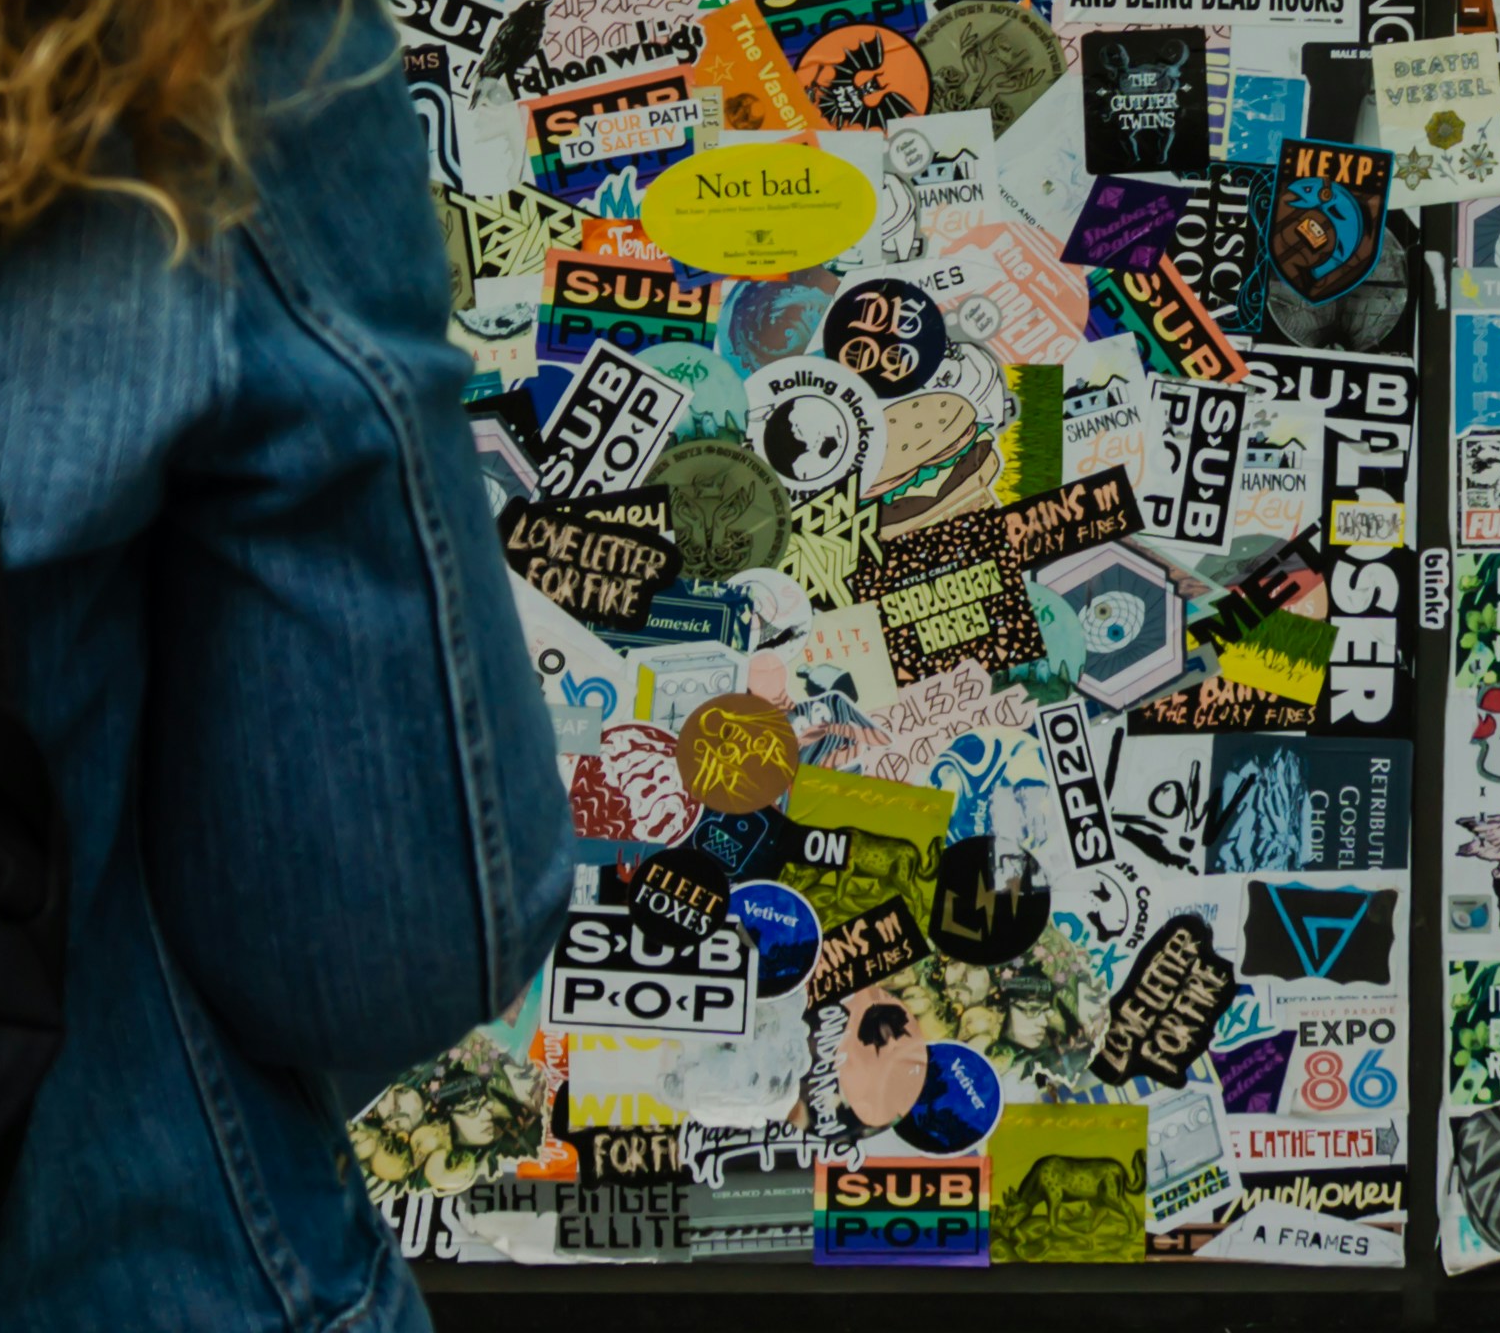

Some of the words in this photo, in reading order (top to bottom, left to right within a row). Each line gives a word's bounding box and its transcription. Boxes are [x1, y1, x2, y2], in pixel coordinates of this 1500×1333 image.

[1128, 73, 1157, 87] THE
[1110, 93, 1179, 112] GUTTER
[586, 117, 639, 135] YOUR
[649, 104, 699, 127] PATH
[1119, 112, 1176, 130] TWINS
[566, 141, 594, 157] TO
[601, 127, 675, 152] SAFETY
[697, 172, 752, 200] Not
[762, 170, 820, 198] bad.
[646, 864, 710, 900] FLEET
[635, 887, 709, 933] FOXES
[1253, 1225, 1266, 1244] A
[1279, 1227, 1369, 1256] FRAMES
